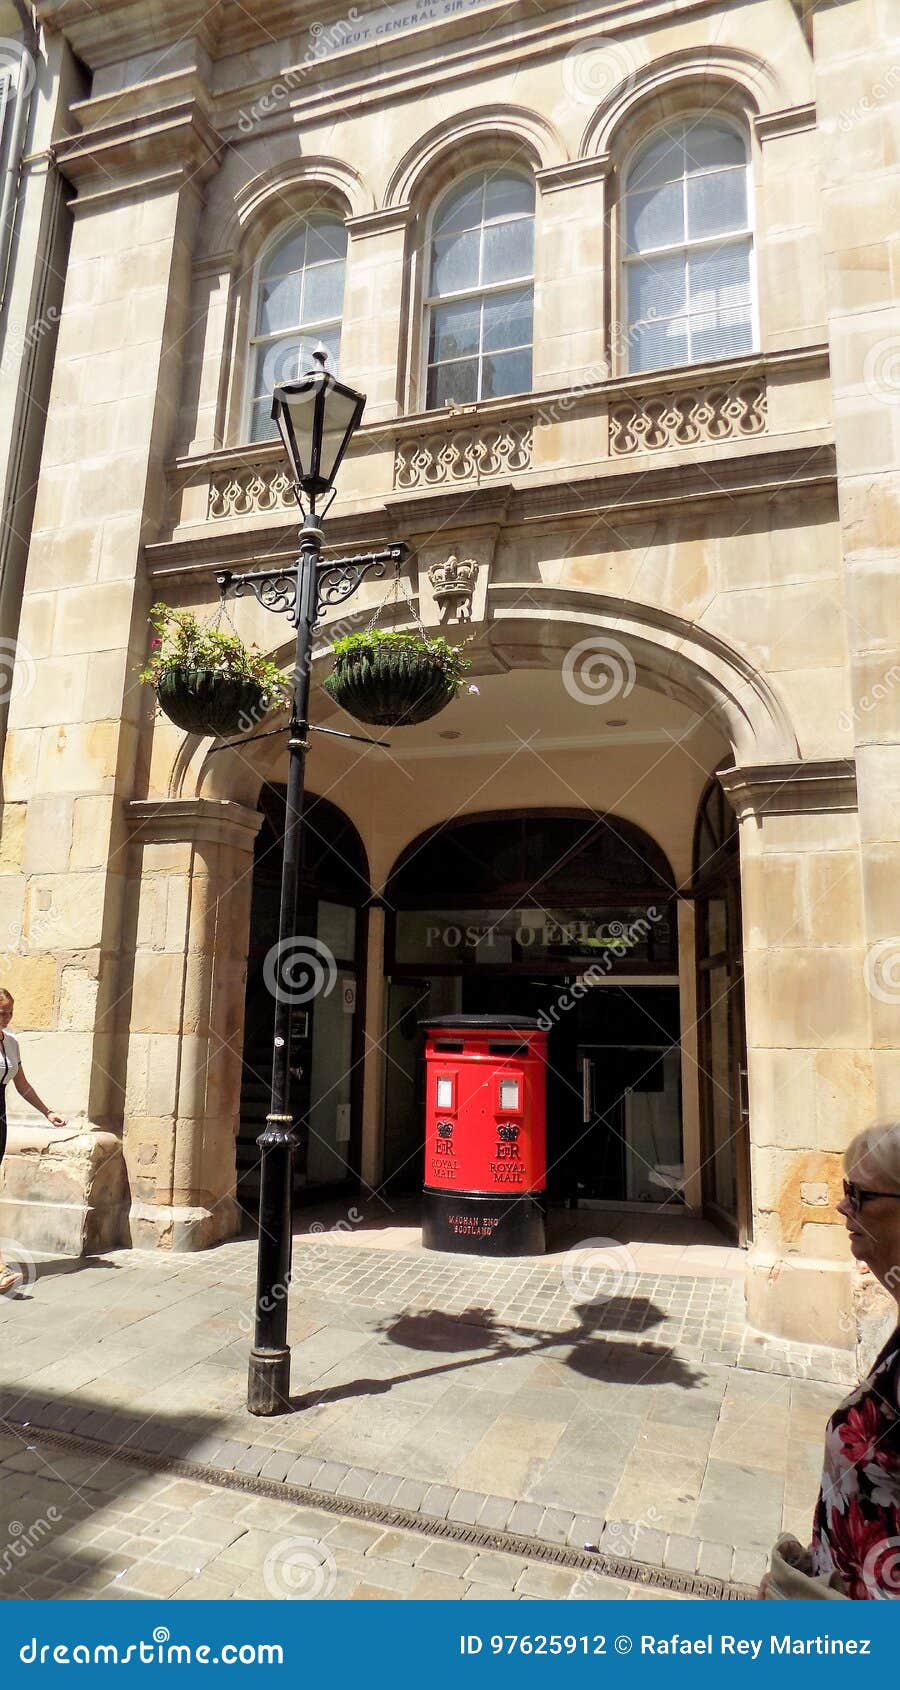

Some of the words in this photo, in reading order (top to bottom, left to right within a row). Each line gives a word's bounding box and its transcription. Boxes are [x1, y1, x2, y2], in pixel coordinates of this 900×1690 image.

[376, 10, 436, 34] GENERAL
[444, 2, 463, 13] SIR
[424, 926, 500, 948] POST
[432, 1159, 459, 1169] ROYAL
[489, 1162, 526, 1174] ROYAL
[433, 1168, 456, 1179] MAIL
[493, 1173, 523, 1184] MAIL
[454, 1225, 493, 1237] SCOTLAND
